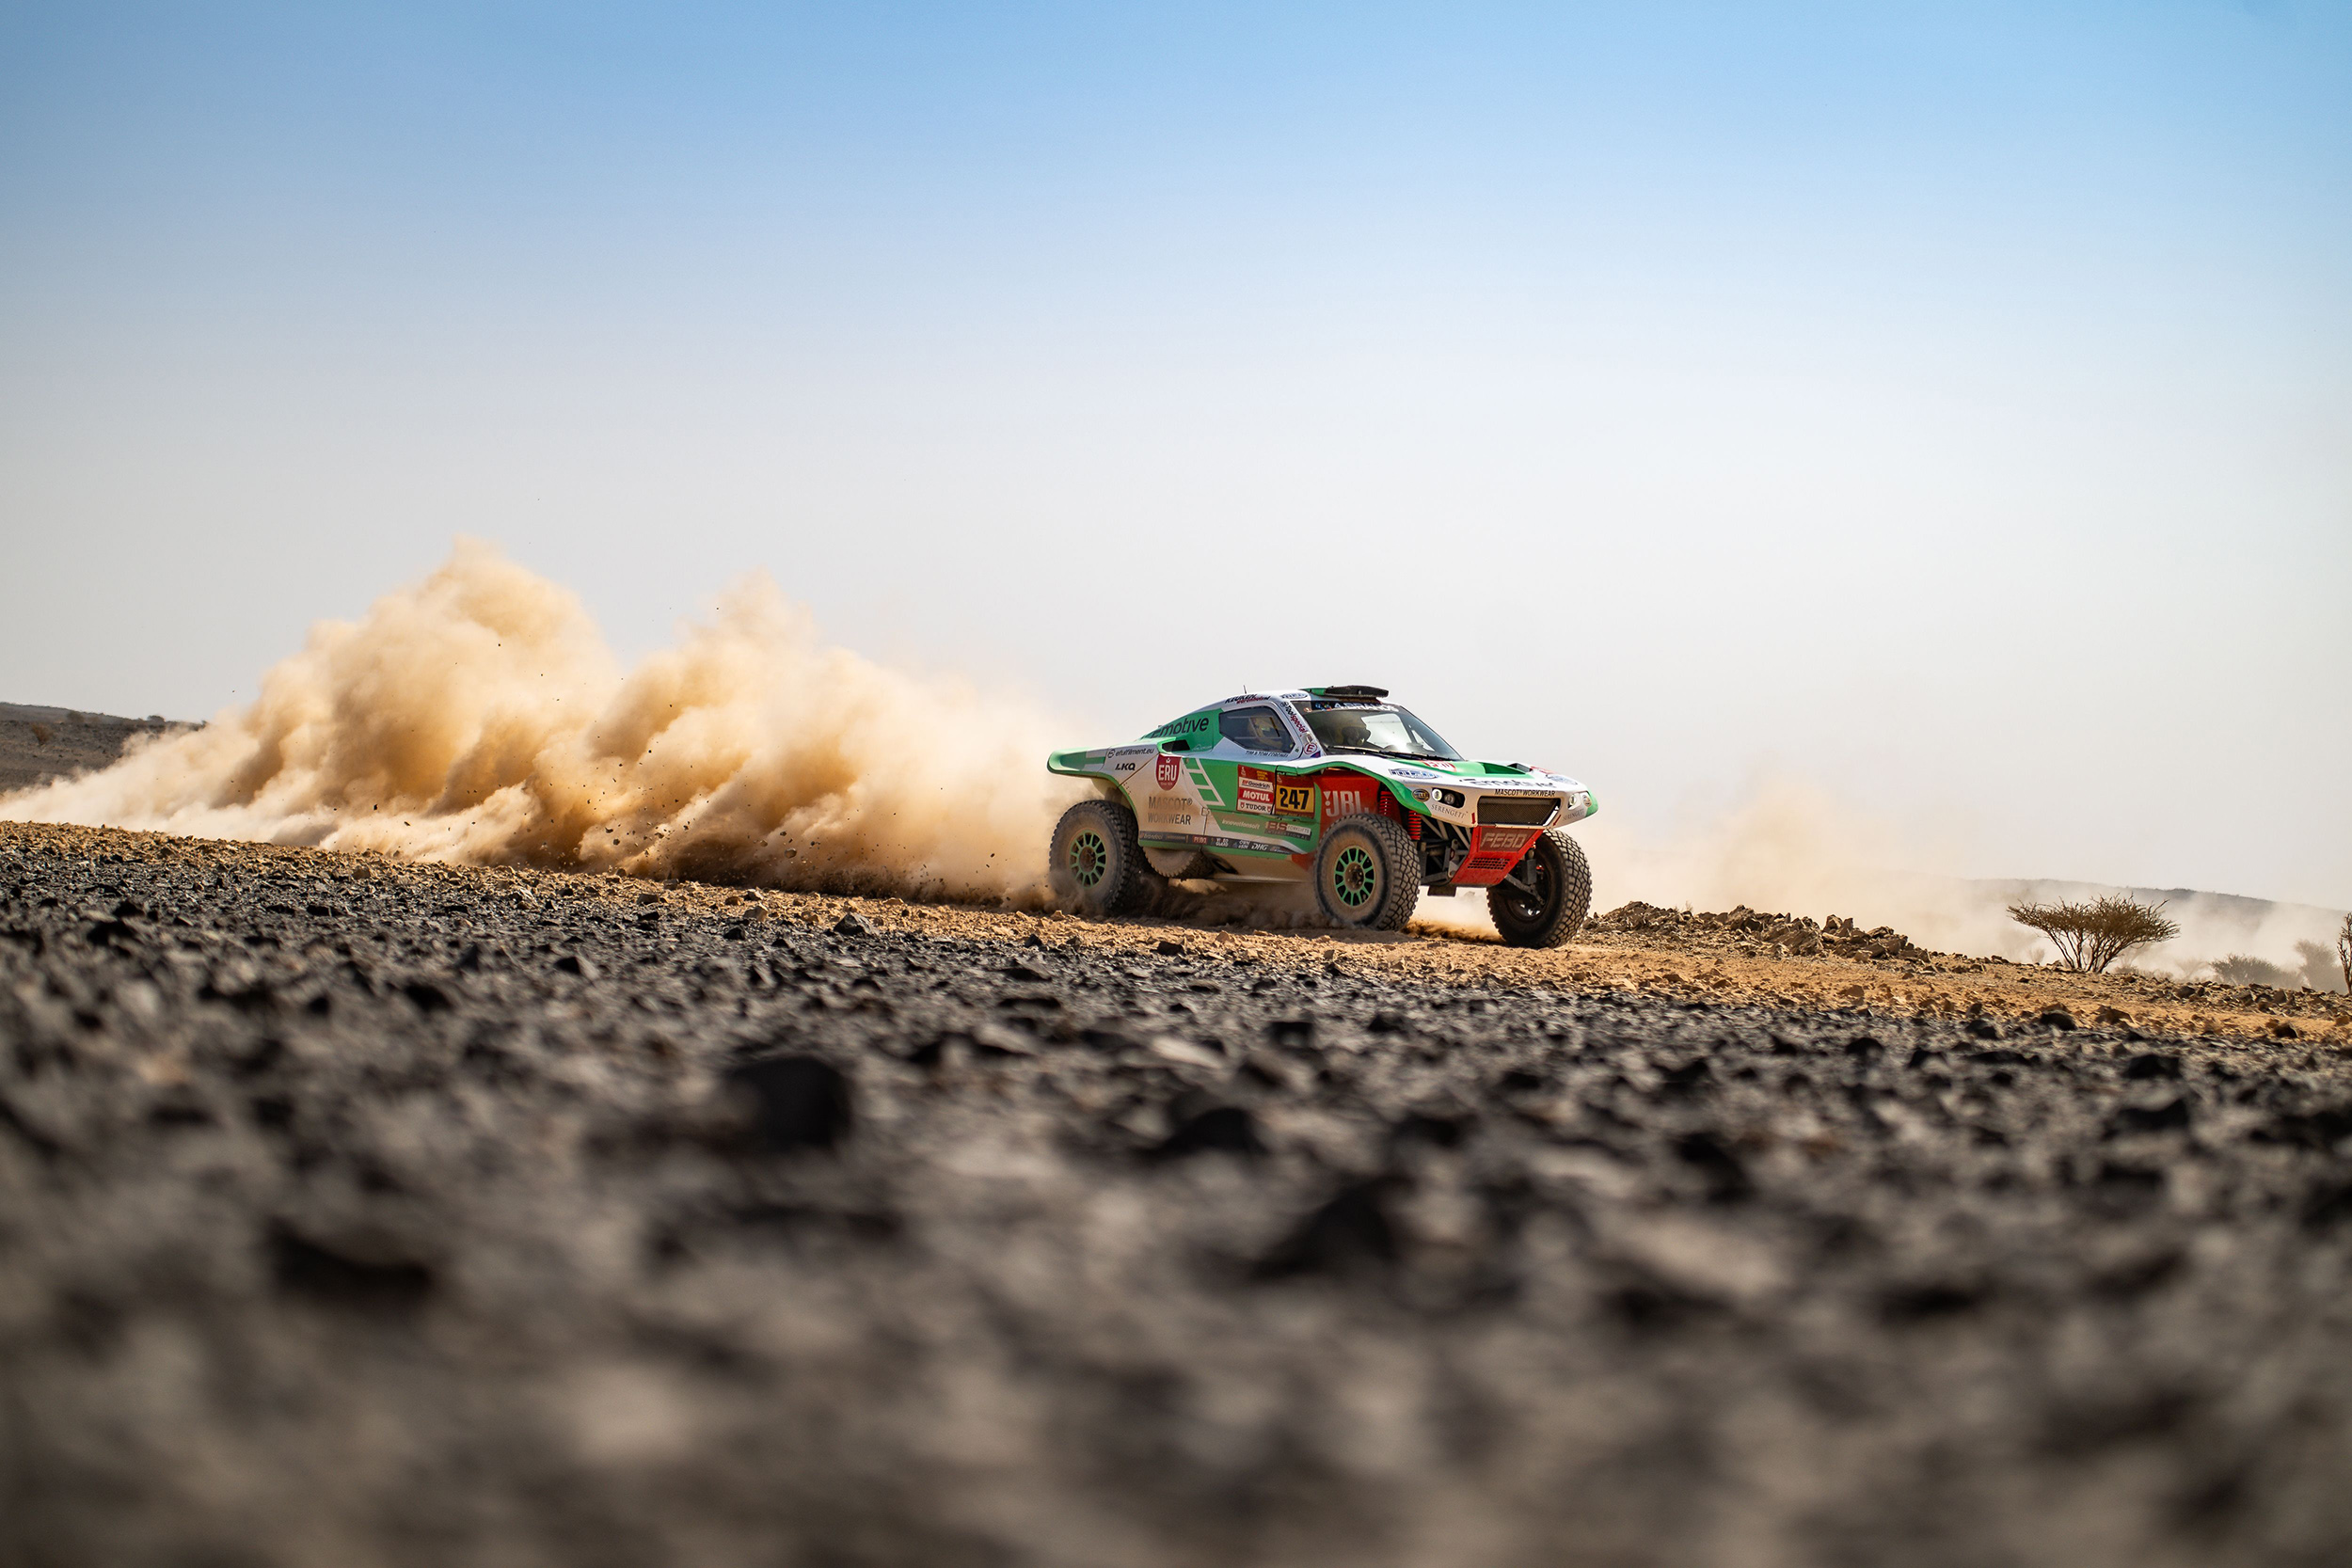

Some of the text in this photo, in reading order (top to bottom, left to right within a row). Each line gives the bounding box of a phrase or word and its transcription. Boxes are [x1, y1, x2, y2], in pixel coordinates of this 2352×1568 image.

[1158, 765, 1178, 782] ERU
[1243, 790, 1270, 801] MOTUL
[1279, 788, 1310, 810] 247
[1325, 790, 1370, 817] JBL
[1149, 813, 1192, 825] WORKWEAR
[1481, 832, 1528, 848] FEBO
